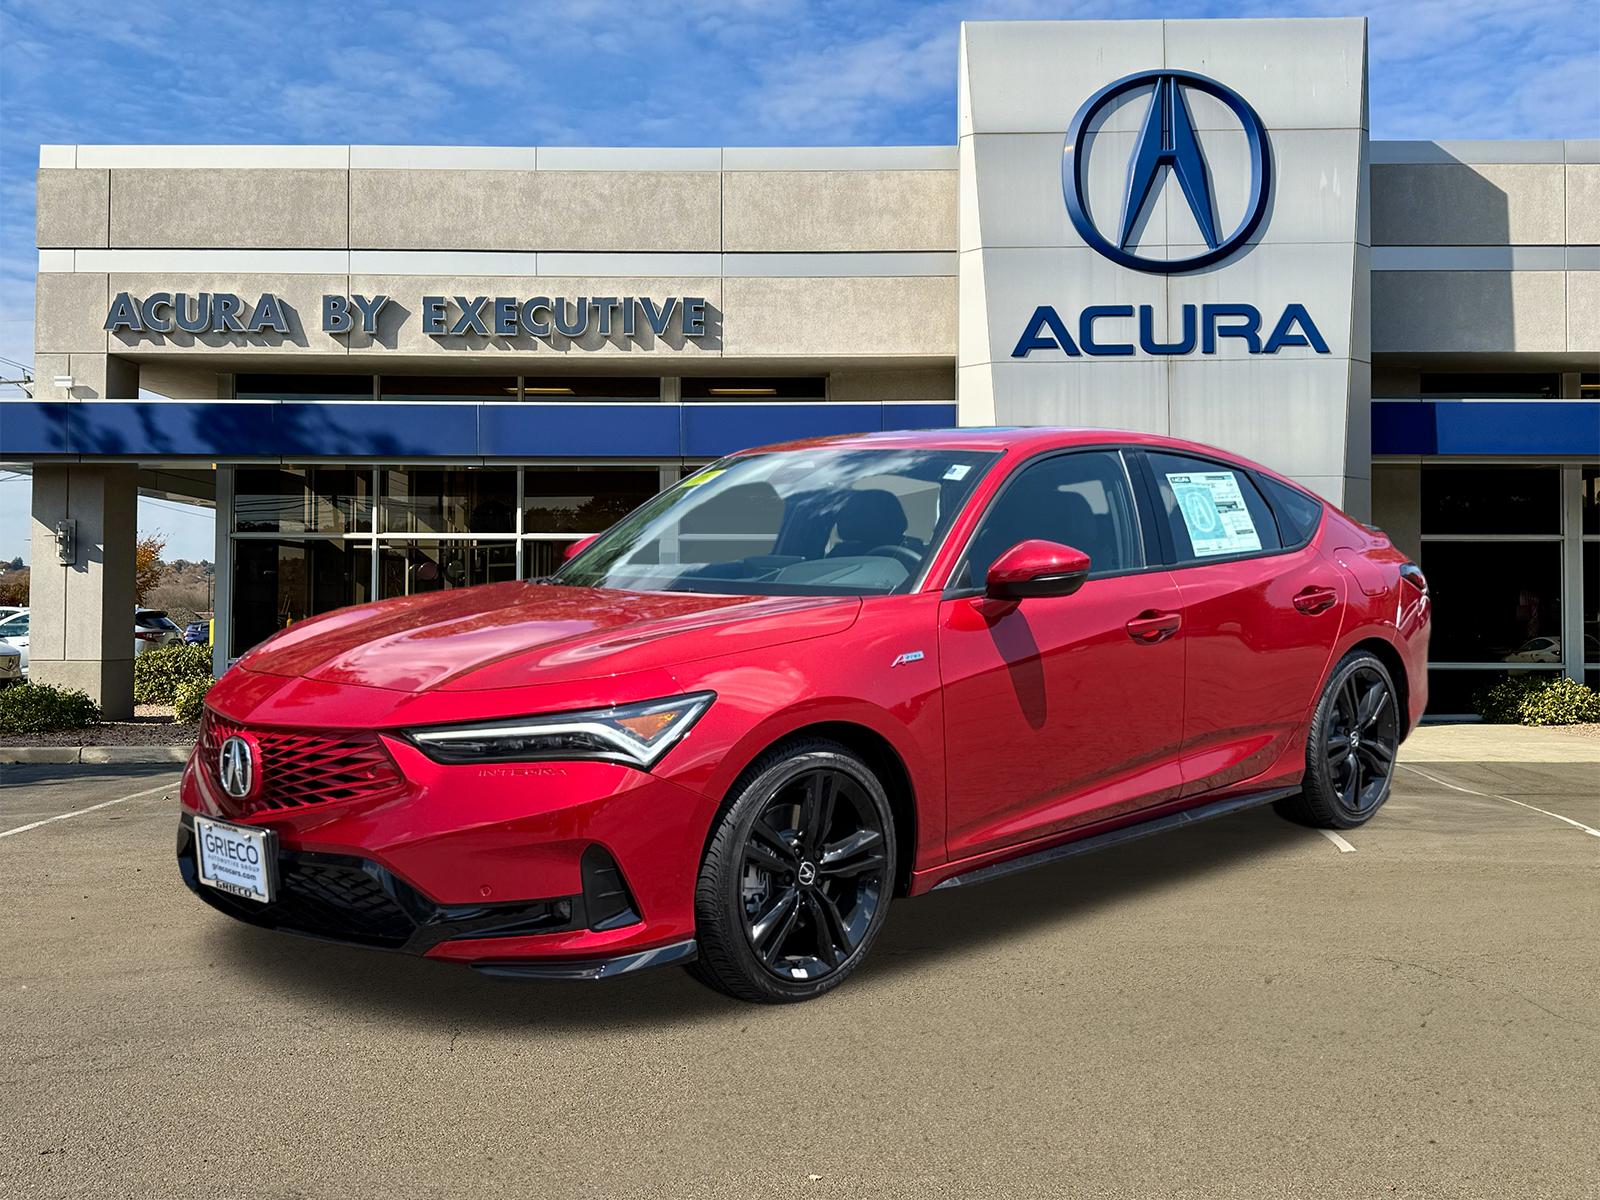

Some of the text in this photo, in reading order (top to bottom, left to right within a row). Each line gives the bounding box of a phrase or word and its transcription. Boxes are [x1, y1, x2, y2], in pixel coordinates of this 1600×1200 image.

[103, 292, 705, 336] ACURA BY EXECUTIVE
[1010, 303, 1331, 357] ACURA
[206, 834, 258, 864] GRIECO
[216, 880, 252, 897] GRIECO
